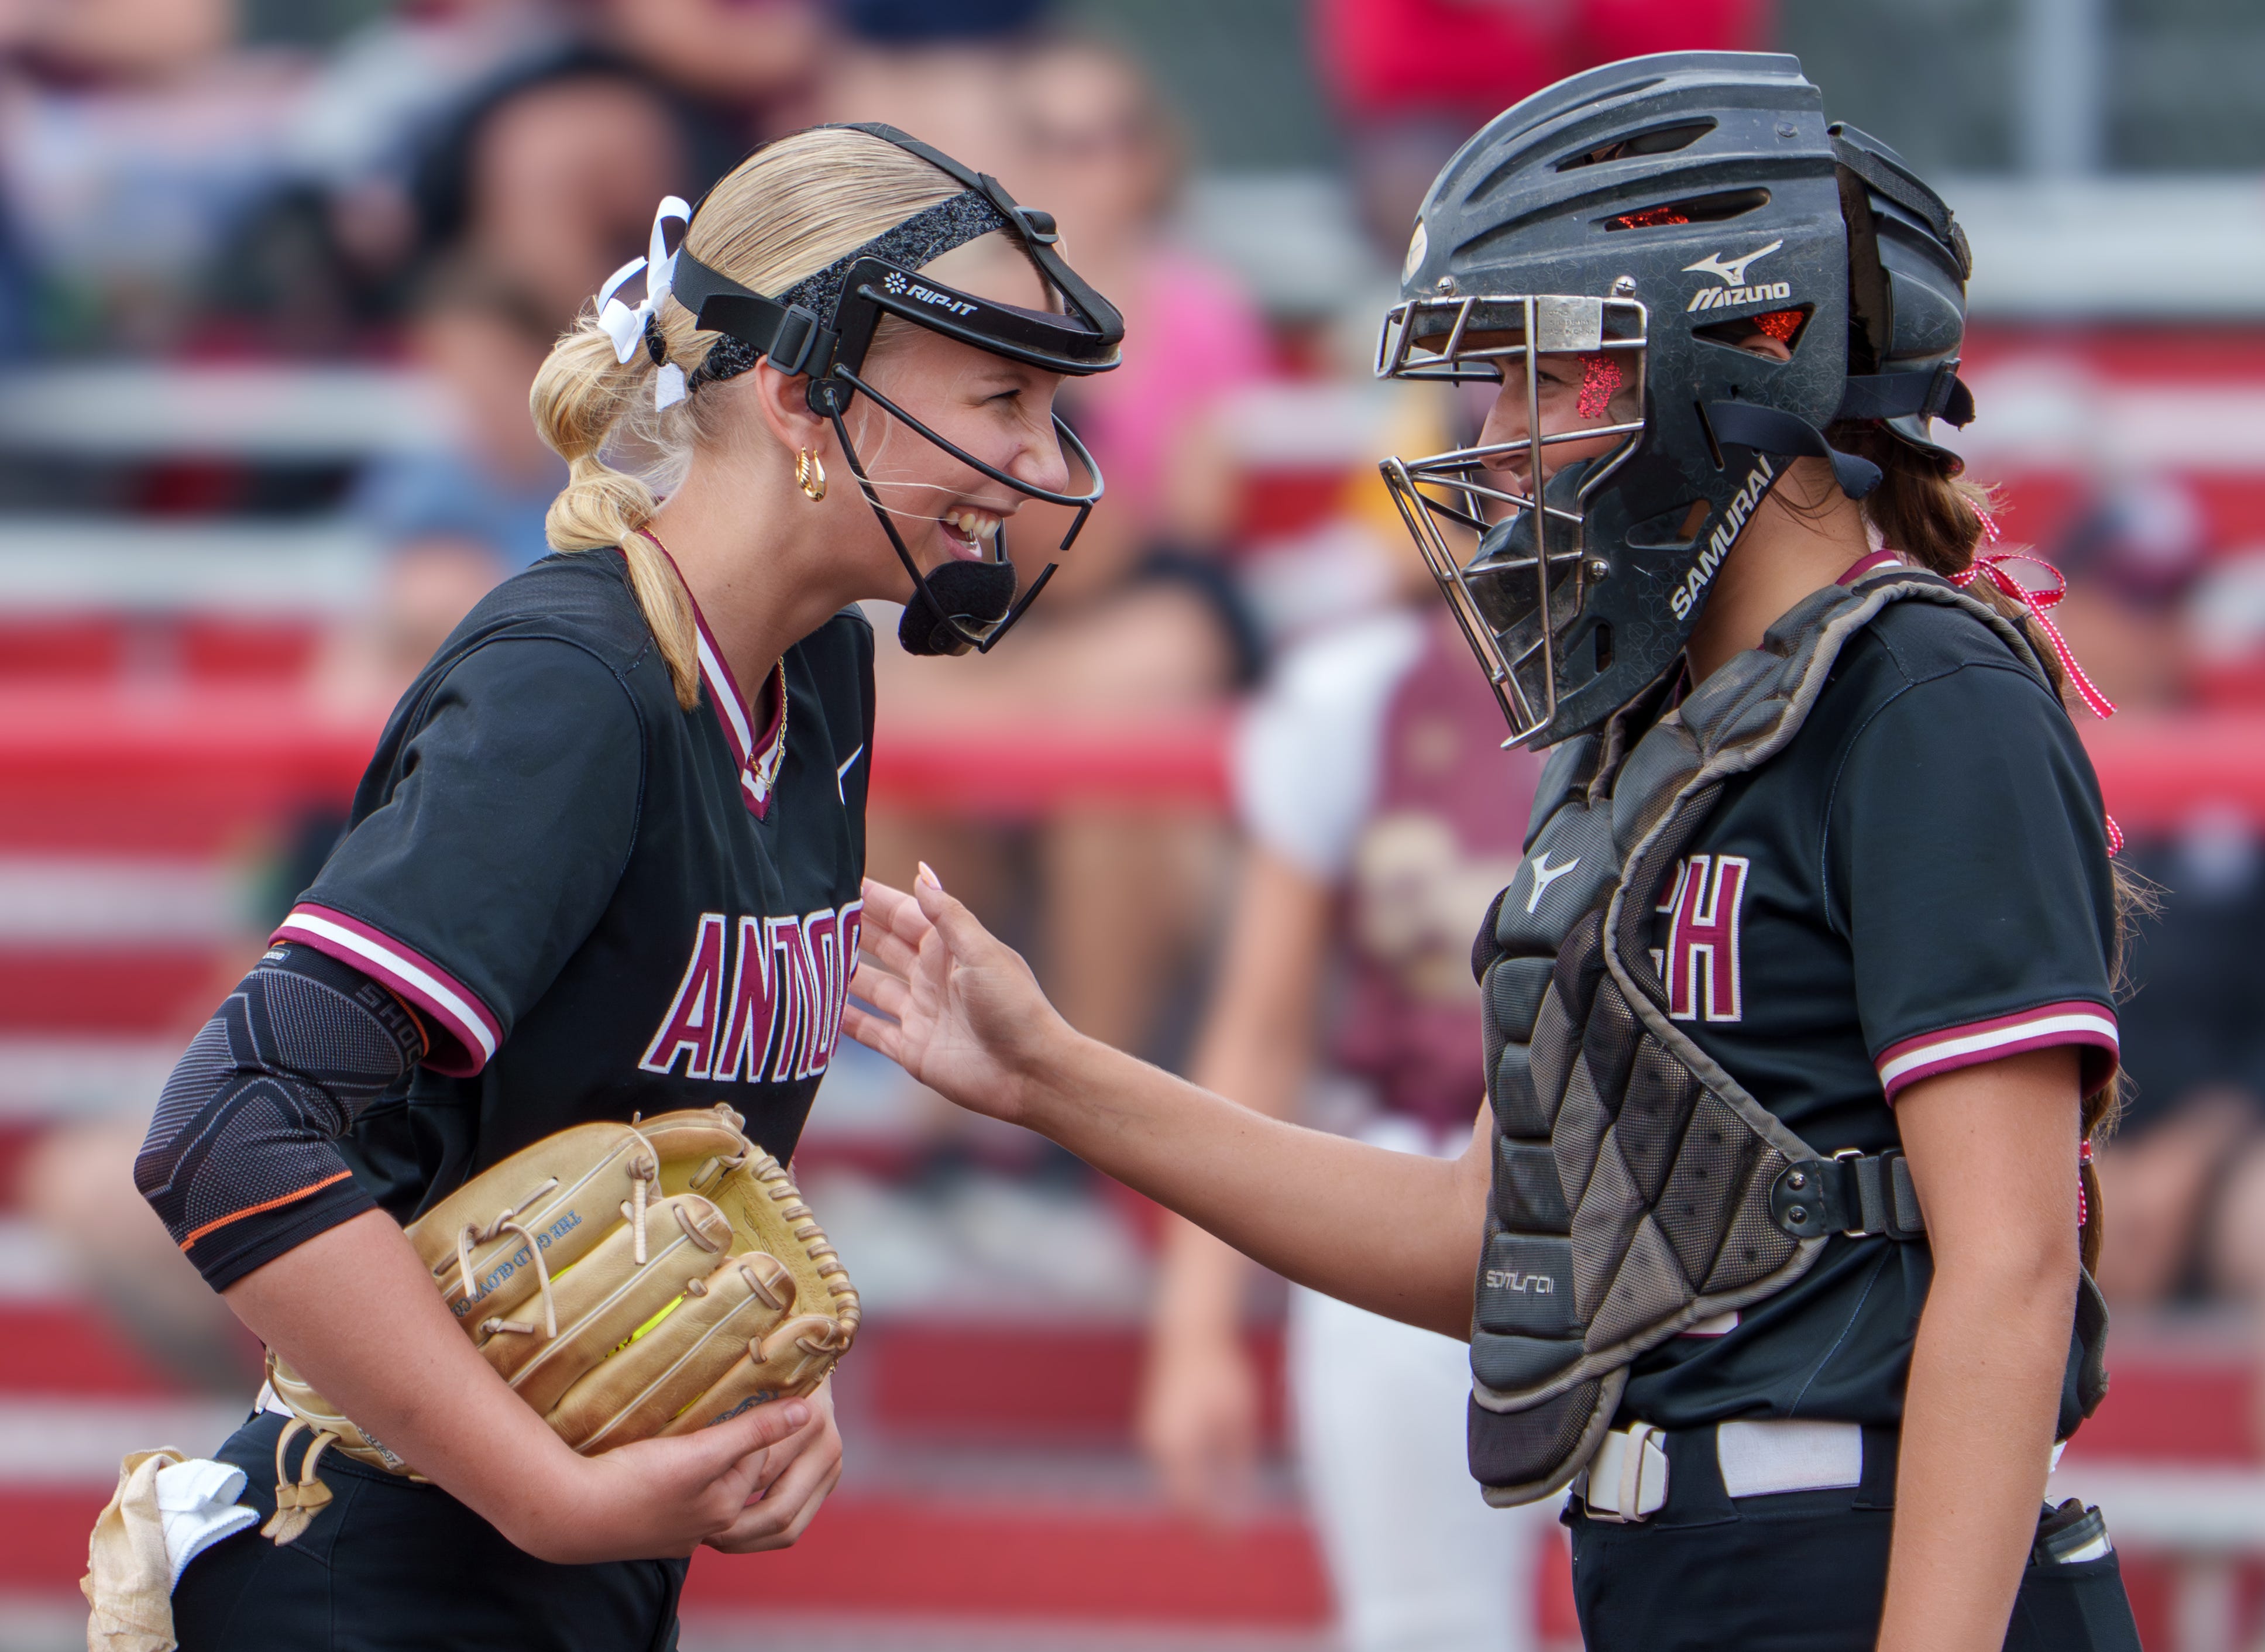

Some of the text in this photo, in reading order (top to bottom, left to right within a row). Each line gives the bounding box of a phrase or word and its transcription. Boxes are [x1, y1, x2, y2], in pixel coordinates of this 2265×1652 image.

[1671, 455, 1774, 621] SAMURAI
[1649, 854, 1750, 1022] H
[355, 983, 422, 1070] SHOC
[548, 1210, 583, 1239] THE
